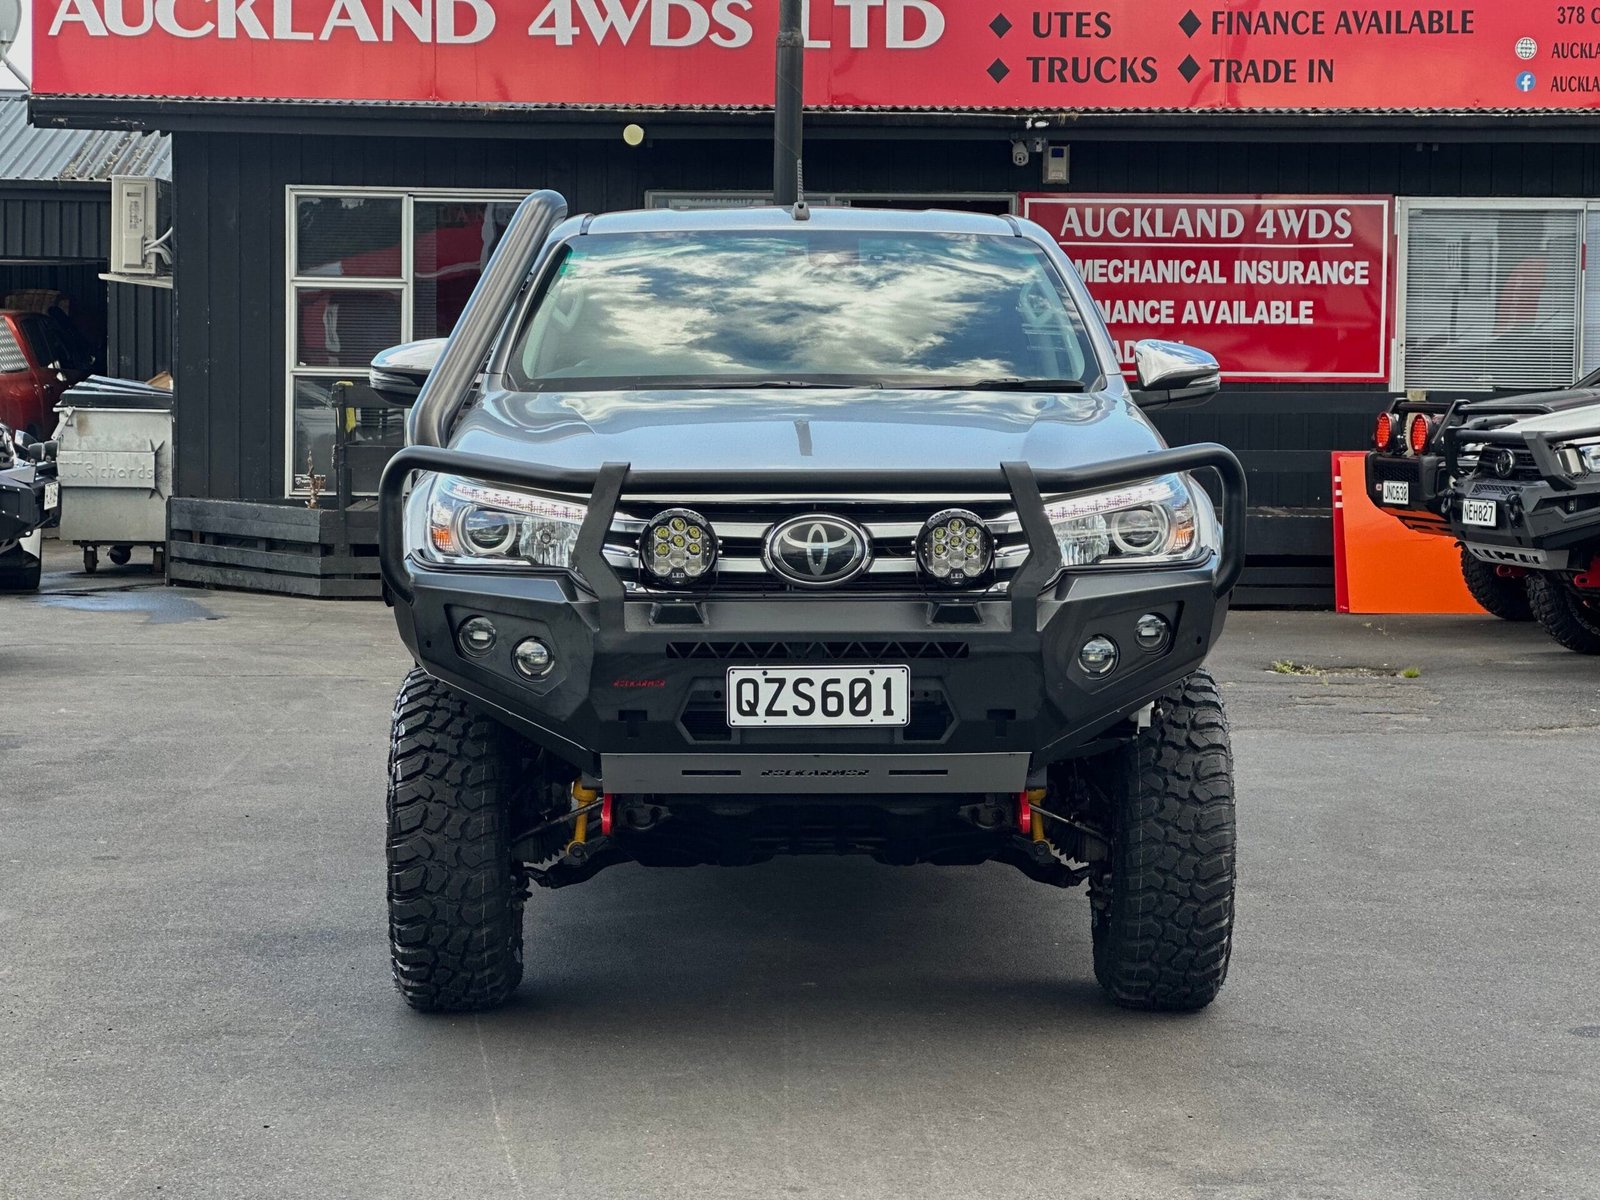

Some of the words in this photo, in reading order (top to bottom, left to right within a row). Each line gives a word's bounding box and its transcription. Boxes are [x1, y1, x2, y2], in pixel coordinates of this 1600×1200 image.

[47, 0, 497, 44] AUCKLAND
[528, 0, 754, 48] 4WDS
[800, 0, 946, 49] LTD
[1032, 11, 1112, 39] UTES
[1211, 10, 1325, 35] FINANCE
[1334, 10, 1475, 35] AVAILABLE
[1557, 6, 1585, 25] 378
[1026, 56, 1158, 84] TRUCKS
[1209, 58, 1297, 83] TRADE
[1308, 58, 1334, 83] IN
[1060, 207, 1245, 238] AUCKLAND
[1255, 208, 1352, 240] 4WDS
[1074, 259, 1227, 284] MECHANICAL
[1234, 260, 1370, 285] INSURANCE
[1095, 299, 1175, 324] NANCE
[1181, 300, 1314, 324] AVAILABLE
[1464, 503, 1494, 522] NEH827
[736, 677, 894, 718] QZS601
